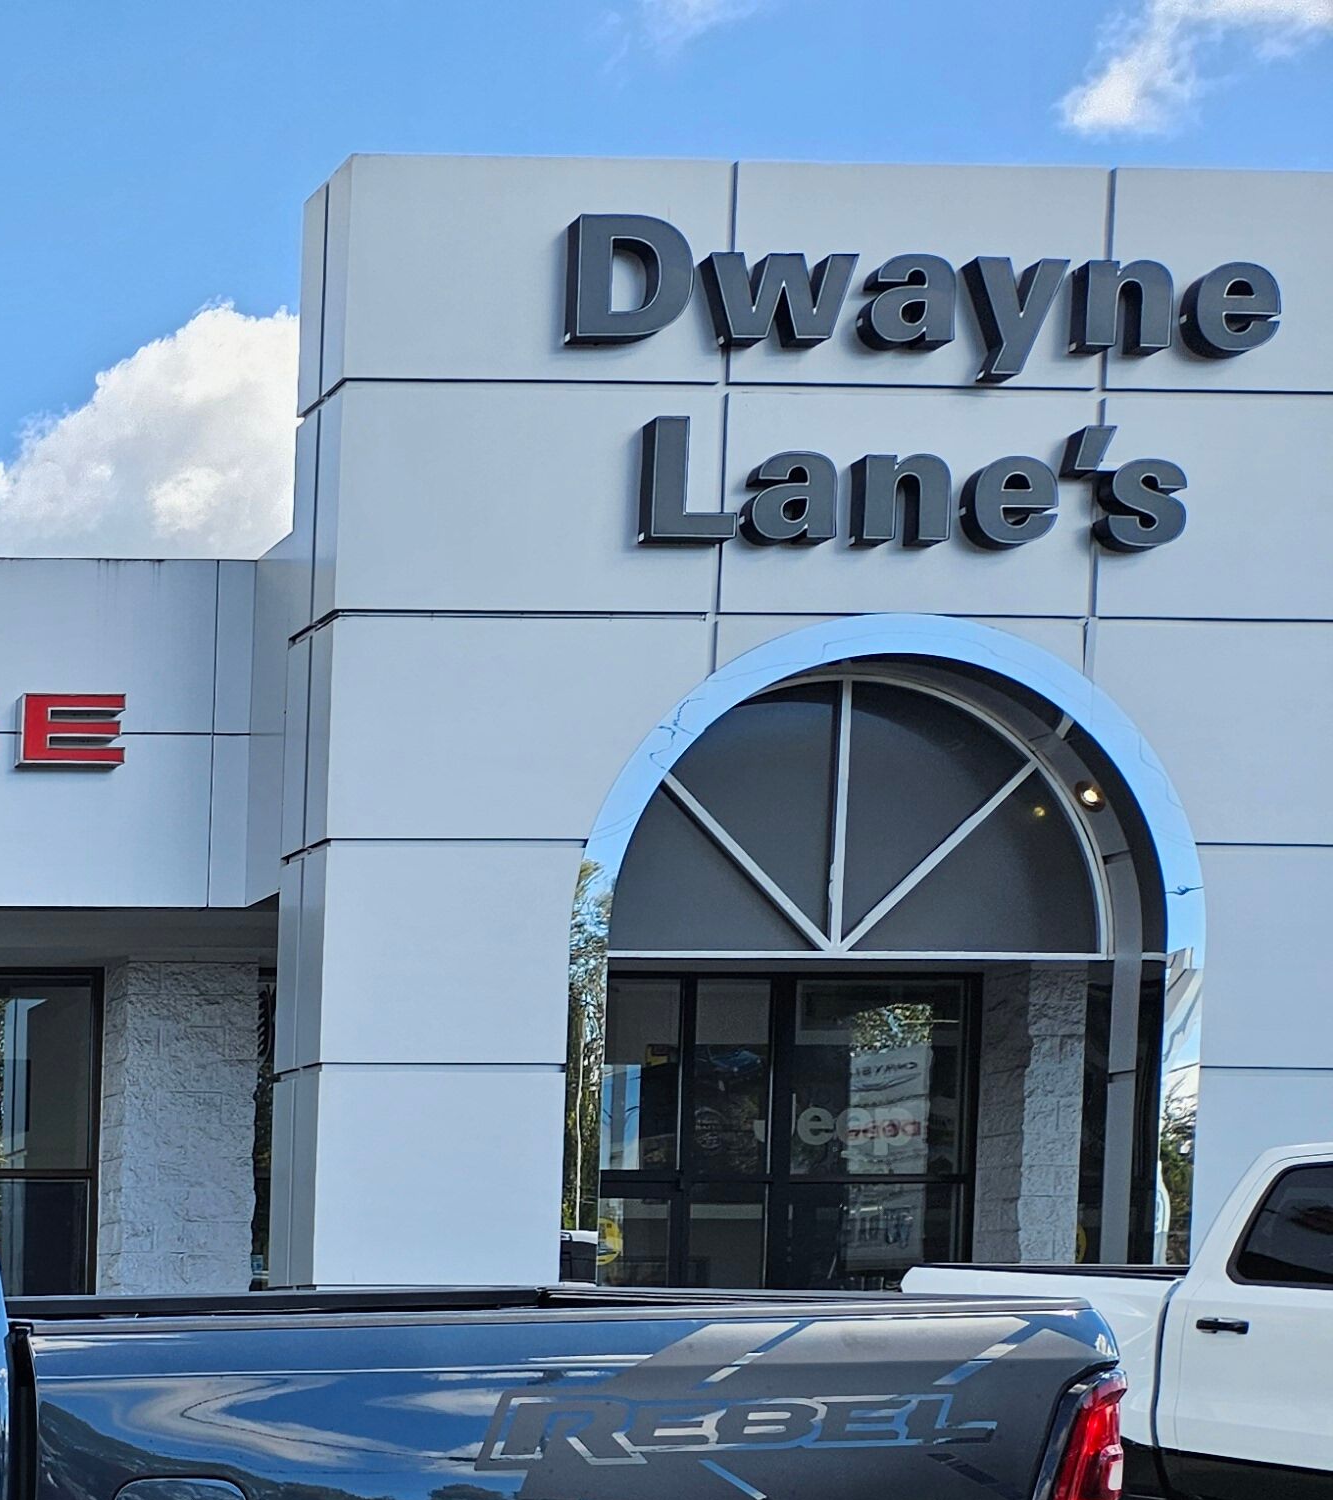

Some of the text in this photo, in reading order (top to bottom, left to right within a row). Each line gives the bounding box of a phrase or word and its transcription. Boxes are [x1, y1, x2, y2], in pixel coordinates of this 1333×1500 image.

[564, 213, 1282, 384] Dwayne
[637, 415, 1188, 553] Lane's
[474, 1392, 997, 1471] REBEL
